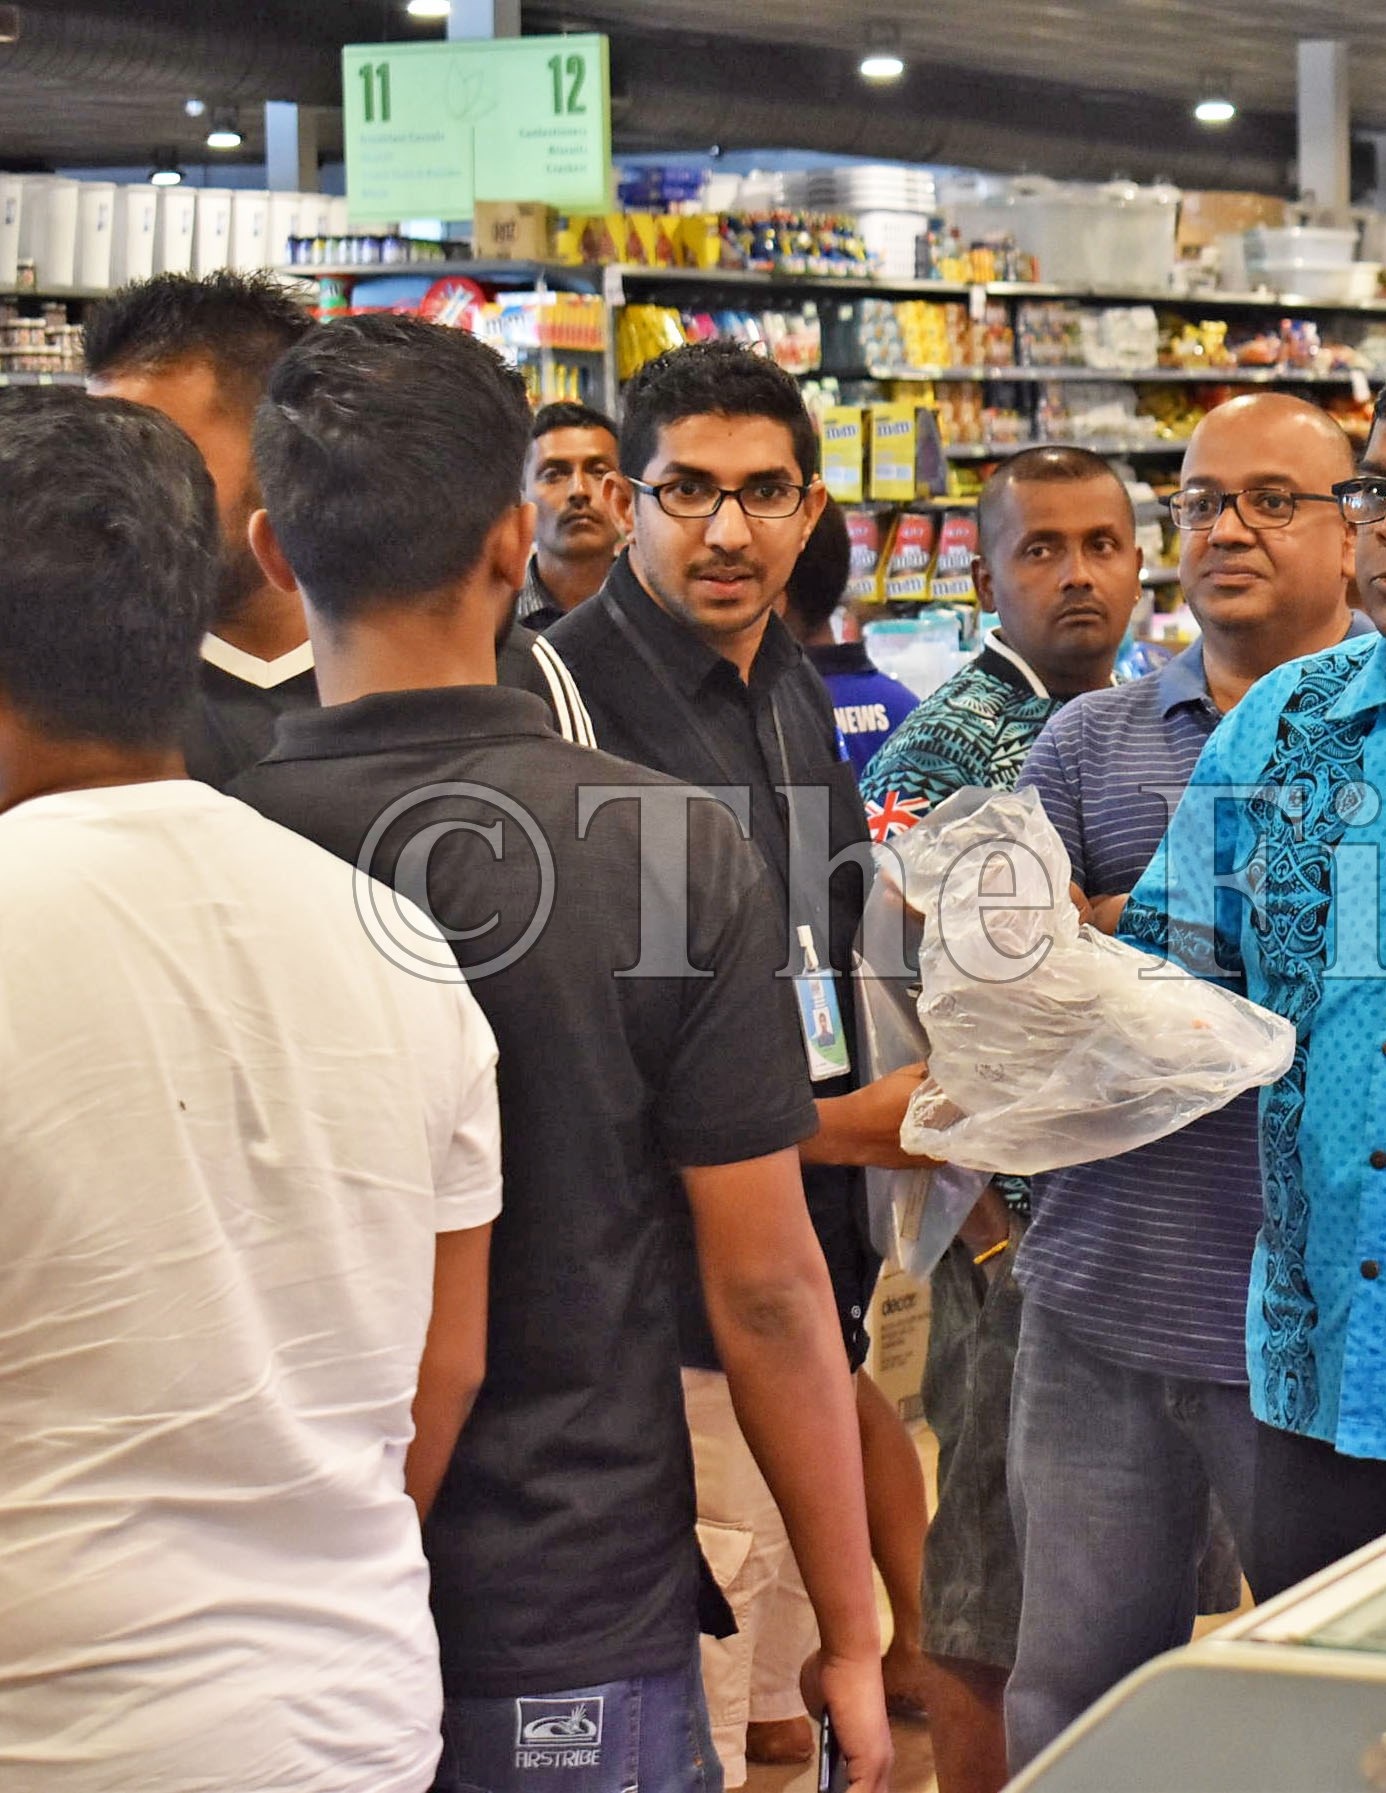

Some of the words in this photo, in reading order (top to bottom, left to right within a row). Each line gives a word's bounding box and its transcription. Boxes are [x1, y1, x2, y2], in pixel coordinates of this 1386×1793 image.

[358, 62, 391, 122] 11
[548, 54, 588, 115] 12
[833, 703, 890, 734] NEWS
